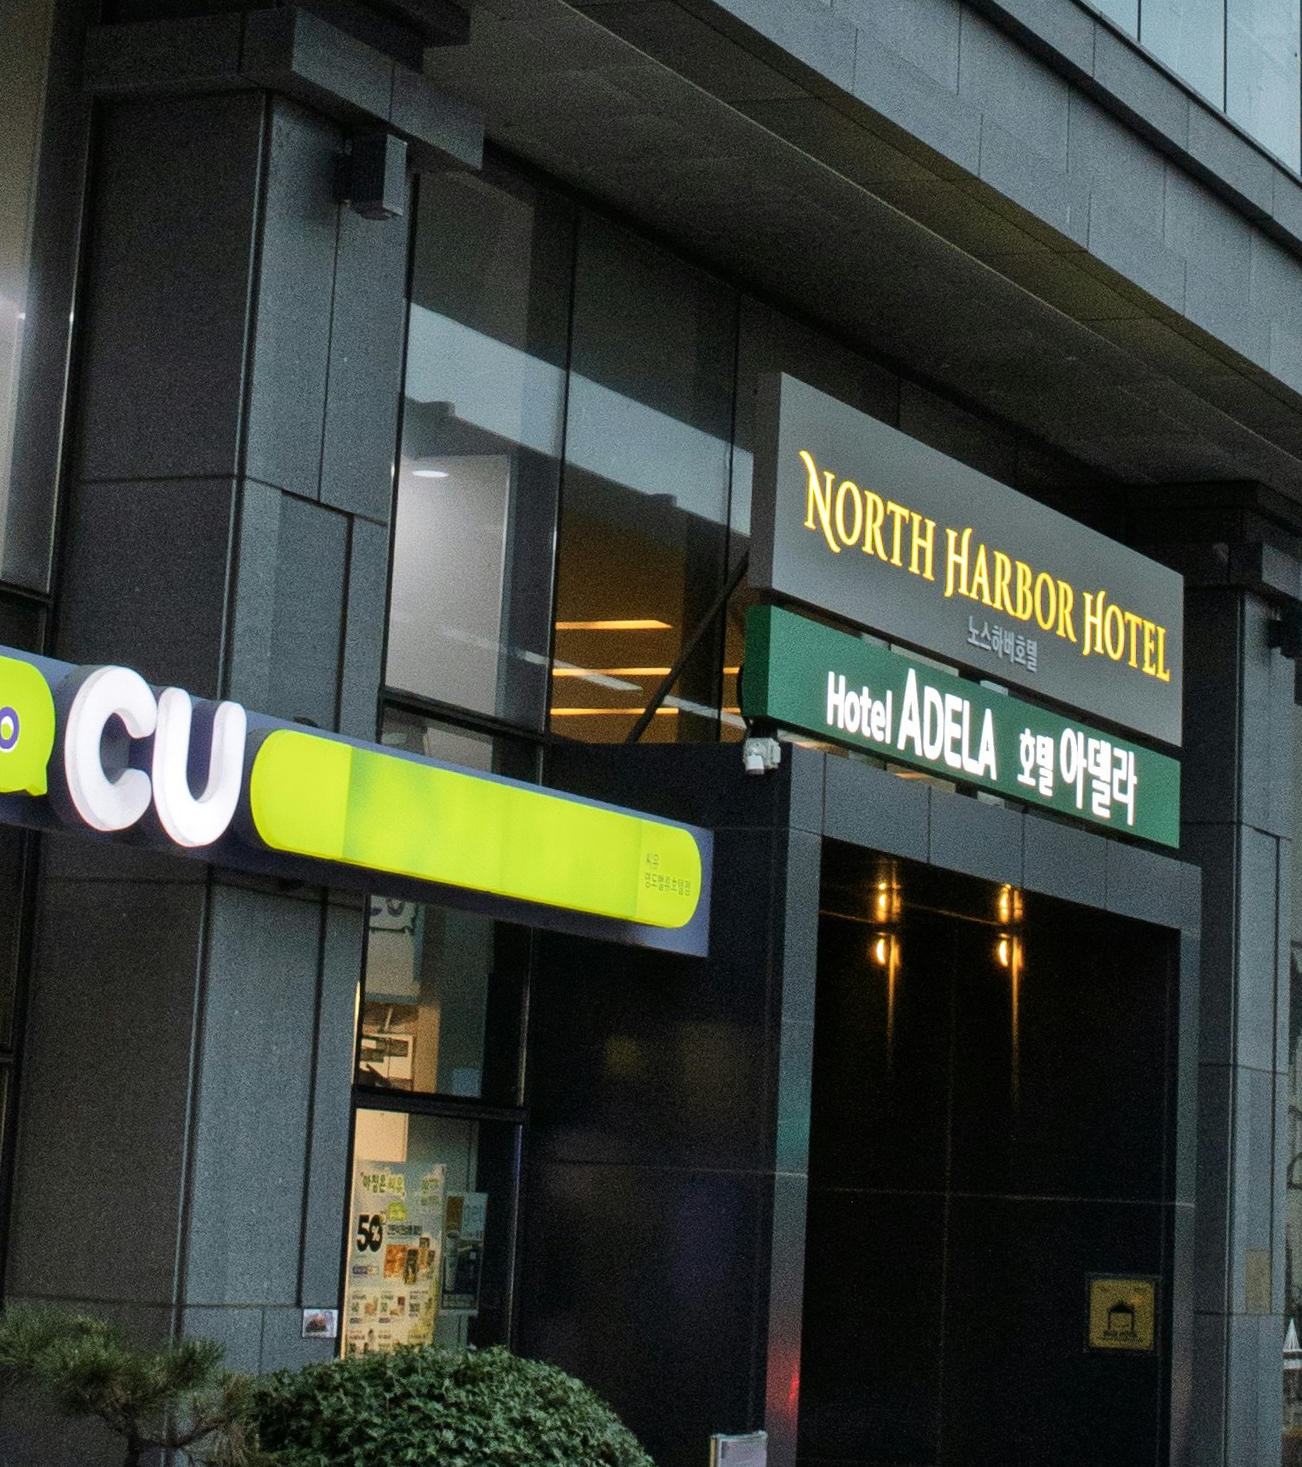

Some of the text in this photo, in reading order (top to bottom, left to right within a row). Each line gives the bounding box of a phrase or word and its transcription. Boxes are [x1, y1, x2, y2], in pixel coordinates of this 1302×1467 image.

[799, 450, 1171, 683] NORTH HARBOR HOTEL
[966, 615, 1038, 673] 노스하버호텔
[64, 665, 248, 848] CU
[826, 667, 1138, 826] Hotel ADELA 호텔 아델라
